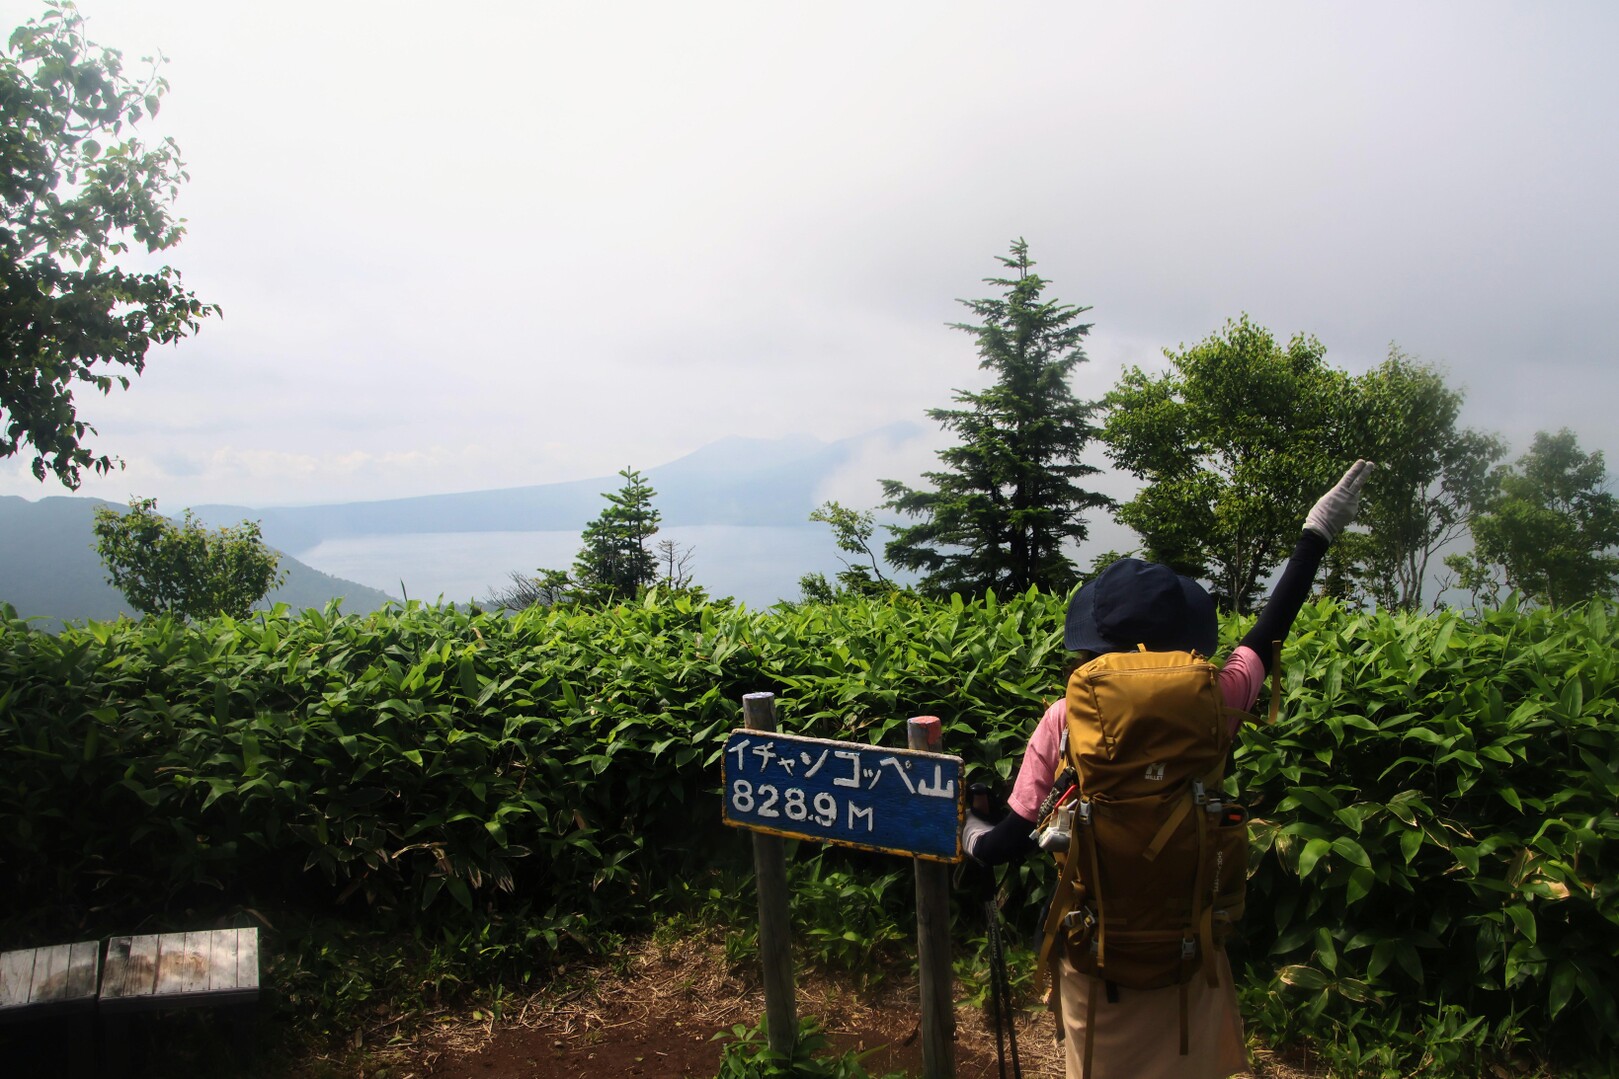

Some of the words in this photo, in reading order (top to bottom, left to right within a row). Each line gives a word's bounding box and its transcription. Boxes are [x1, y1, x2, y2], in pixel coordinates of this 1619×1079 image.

[728, 739, 954, 799] イチャンコッペ山
[732, 779, 838, 827] 828.9
[848, 800, 874, 832] M
